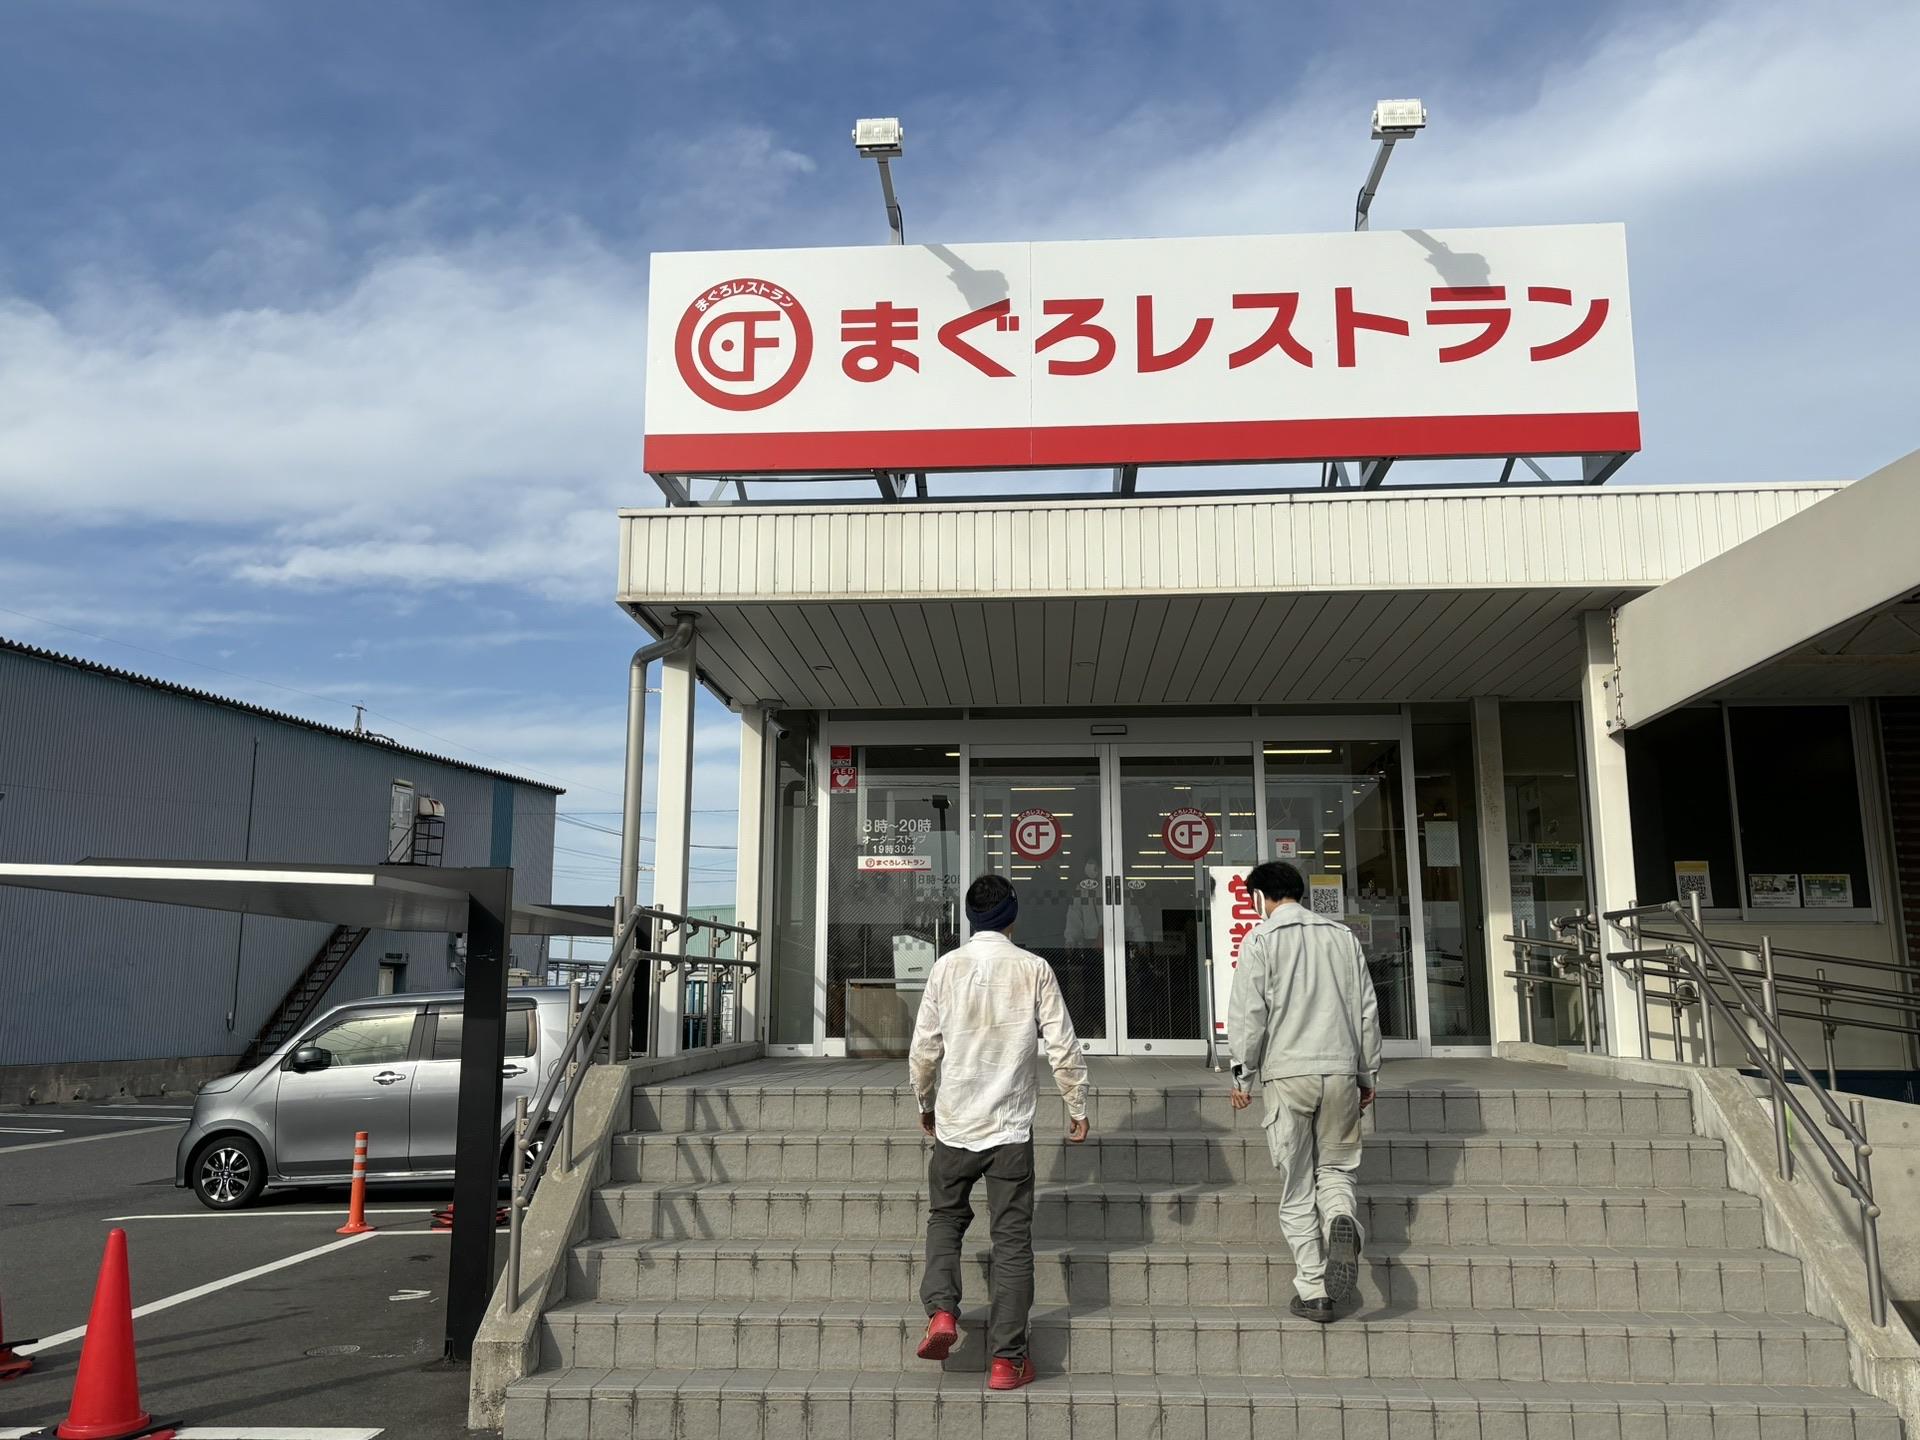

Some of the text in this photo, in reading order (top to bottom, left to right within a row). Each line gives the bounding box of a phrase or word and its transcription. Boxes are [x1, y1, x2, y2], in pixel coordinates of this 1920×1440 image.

[695, 281, 795, 312] まぐろレストラン
[841, 286, 1610, 383] まぐろレストラン
[832, 767, 855, 775] AED
[1016, 808, 1055, 822] まぐろレストラン
[1168, 808, 1208, 822] まぐろレストラン
[862, 835, 926, 845] オーダーストップ
[873, 845, 916, 854] 19時30分
